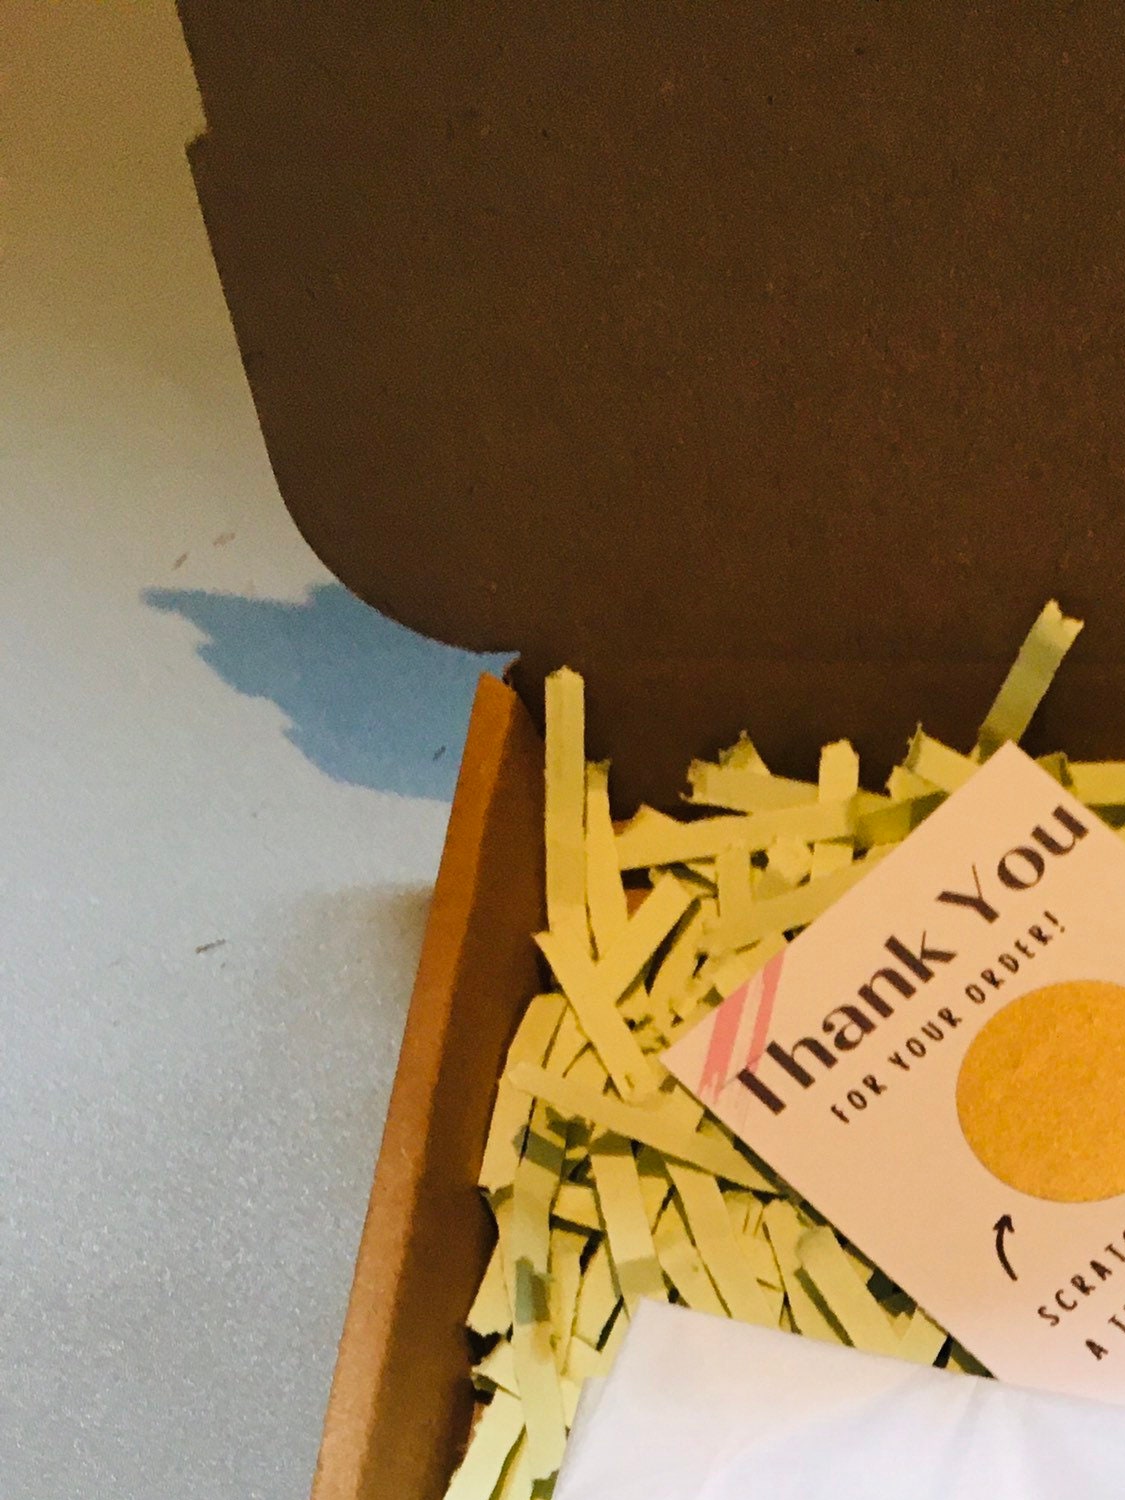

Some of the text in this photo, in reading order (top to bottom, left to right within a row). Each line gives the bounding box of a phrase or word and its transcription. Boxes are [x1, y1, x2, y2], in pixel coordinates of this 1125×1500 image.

[724, 805, 1089, 1116] Thank You
[830, 910, 1068, 1124] FOR YOUR ORDER!
[1085, 1338, 1109, 1361] A
